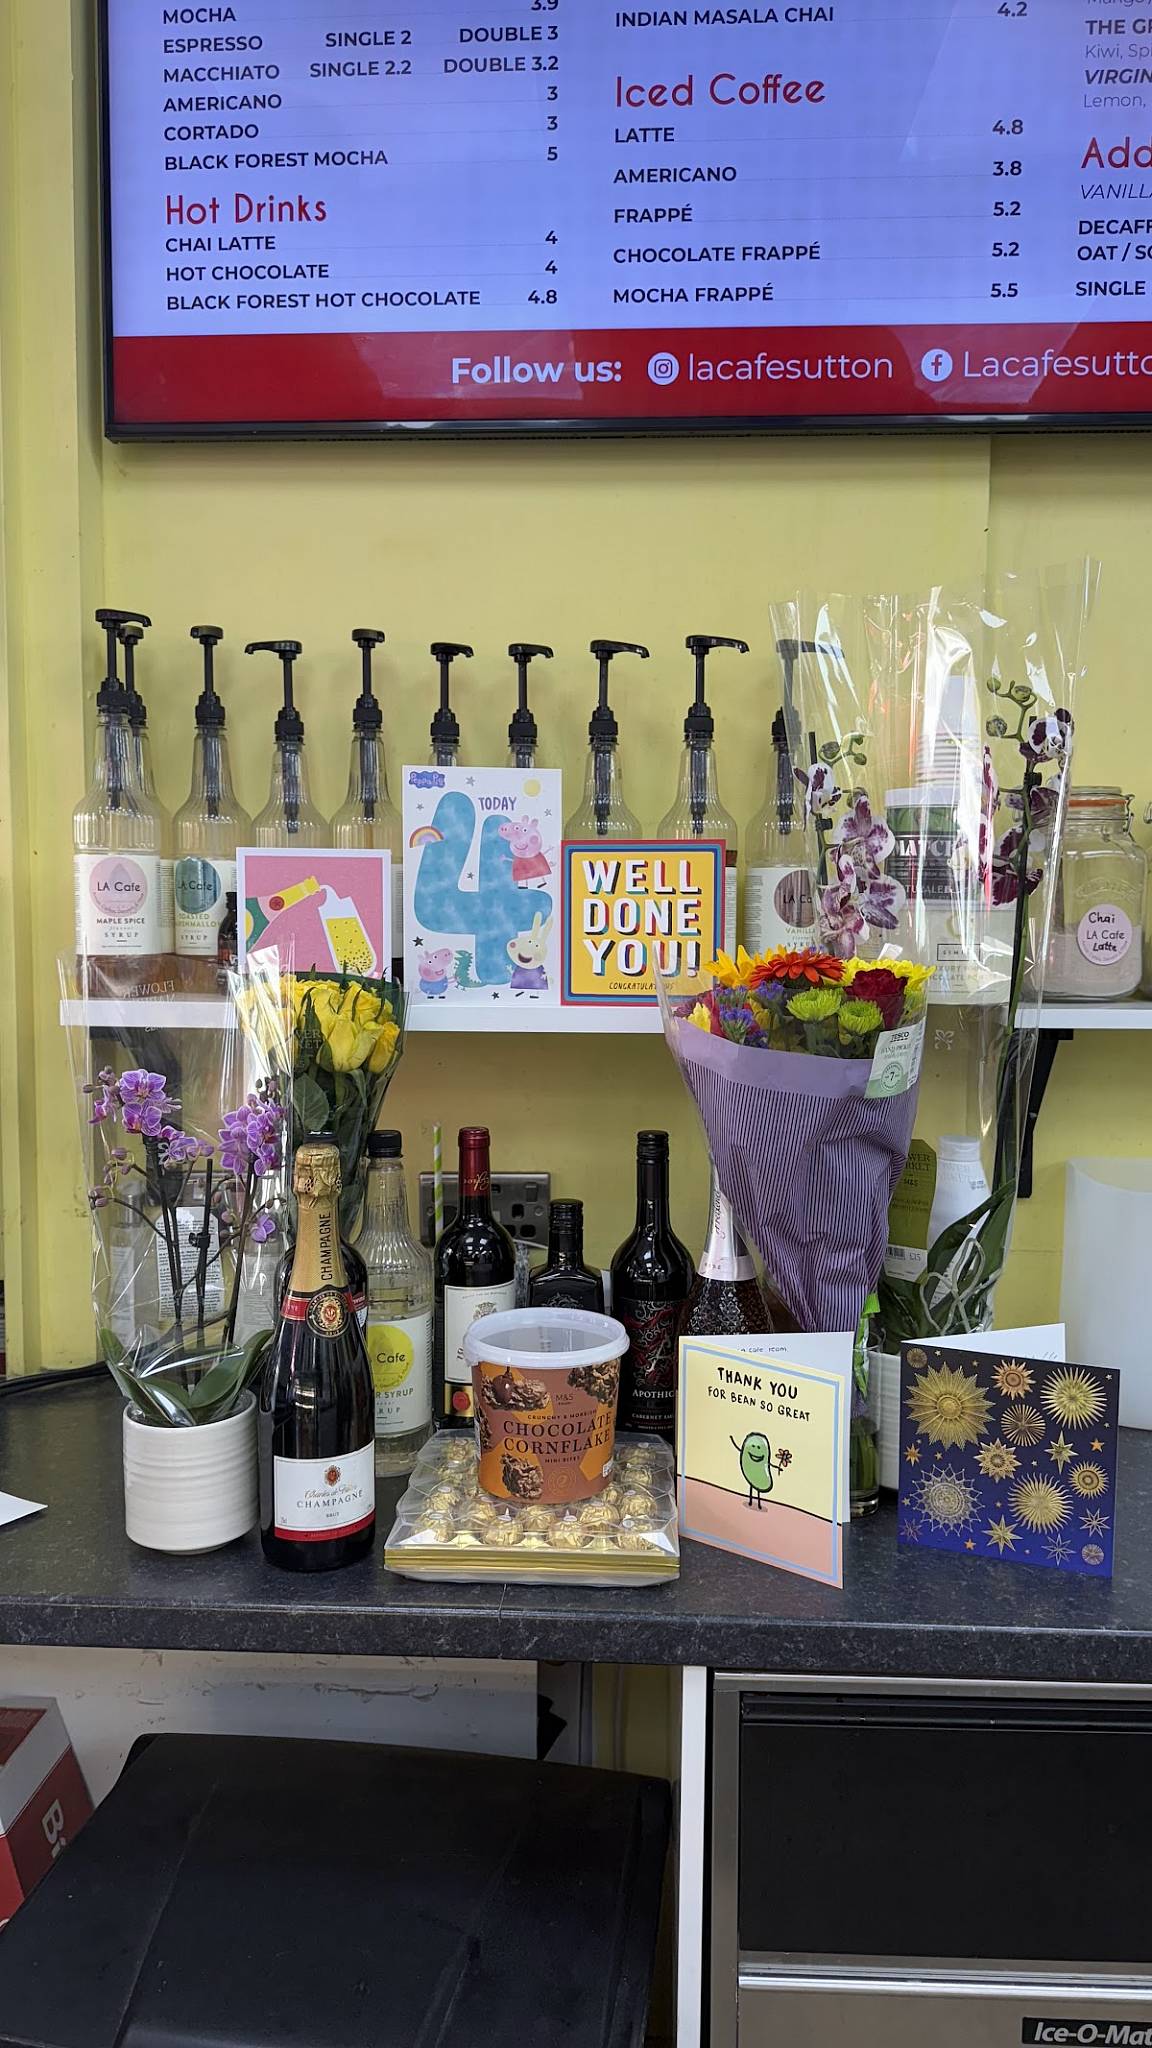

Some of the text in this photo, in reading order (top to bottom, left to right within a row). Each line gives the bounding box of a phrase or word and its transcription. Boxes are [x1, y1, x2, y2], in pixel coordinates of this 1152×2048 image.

[163, 0, 559, 25] MOCHA 3.9
[616, 1, 1028, 28] INDIAN MASALA CHAI 4.2
[1084, 19, 1126, 35] THE
[163, 25, 559, 54] ESPRESSO SINGLE 2 DOUBLE 3
[1084, 43, 1152, 60] Kiwi, Sp
[163, 55, 559, 83] MACCHIATO SINGLE 2.2 DOUBLE 3.2
[1084, 67, 1152, 85] VIRGIN
[163, 85, 558, 113] AMERICANO 3
[616, 73, 826, 108] Iced Coffee
[1083, 93, 1147, 109] Lemon,
[163, 115, 558, 141] CORTADO 3
[615, 119, 1024, 143] LATTE 4.8
[165, 146, 558, 171] BLACK FOREST MOCHA 5
[613, 160, 1022, 184] AMERICANO 3.8
[1081, 183, 1152, 200] VANILL
[166, 193, 327, 225] Hot Drinks
[614, 200, 1021, 224] FRAPPÉ 5.2
[165, 230, 558, 253] CHAI LATTE 4
[613, 241, 1020, 264] CHOCOLATE FRAPPÉ 5.2
[1077, 245, 1119, 261] OAT
[1121, 242, 1132, 262] /
[166, 260, 558, 282] HOT CHOCOLATE 4
[167, 289, 558, 311] BLACK FOREST HOT CHOCOLATE 4.8
[613, 282, 1018, 304] MOCHA FRAPPÉ 5.5
[1075, 280, 1147, 297] SINGLE
[451, 356, 622, 384] Follow us:
[689, 352, 894, 383] lacafesutton
[478, 796, 517, 811] TODAY
[97, 881, 142, 892] LA Cafe
[582, 859, 702, 895] WELL
[783, 894, 796, 904] LA
[96, 917, 146, 925] MAPLE SPICE
[583, 898, 702, 936] DONE
[1088, 912, 1115, 923] Chai
[1086, 929, 1125, 940] LA Cafe
[583, 938, 701, 977] YOU!
[1092, 942, 1118, 952] Latte
[891, 1031, 910, 1040] TESCO
[319, 1211, 333, 1281] CHAMPAGNE
[376, 1352, 406, 1364] Cafe
[384, 1387, 414, 1399] SYRUP
[632, 1389, 675, 1399] APOTHIC
[717, 1367, 799, 1400] THANK YOU
[708, 1386, 811, 1422] FOR BEAN SO GREAT
[503, 1411, 612, 1437] CHOCOLATE
[503, 1429, 611, 1455] CORNFLAKE
[296, 1489, 363, 1509] CHAMPAGNE
[41, 1798, 68, 1859] Bi
